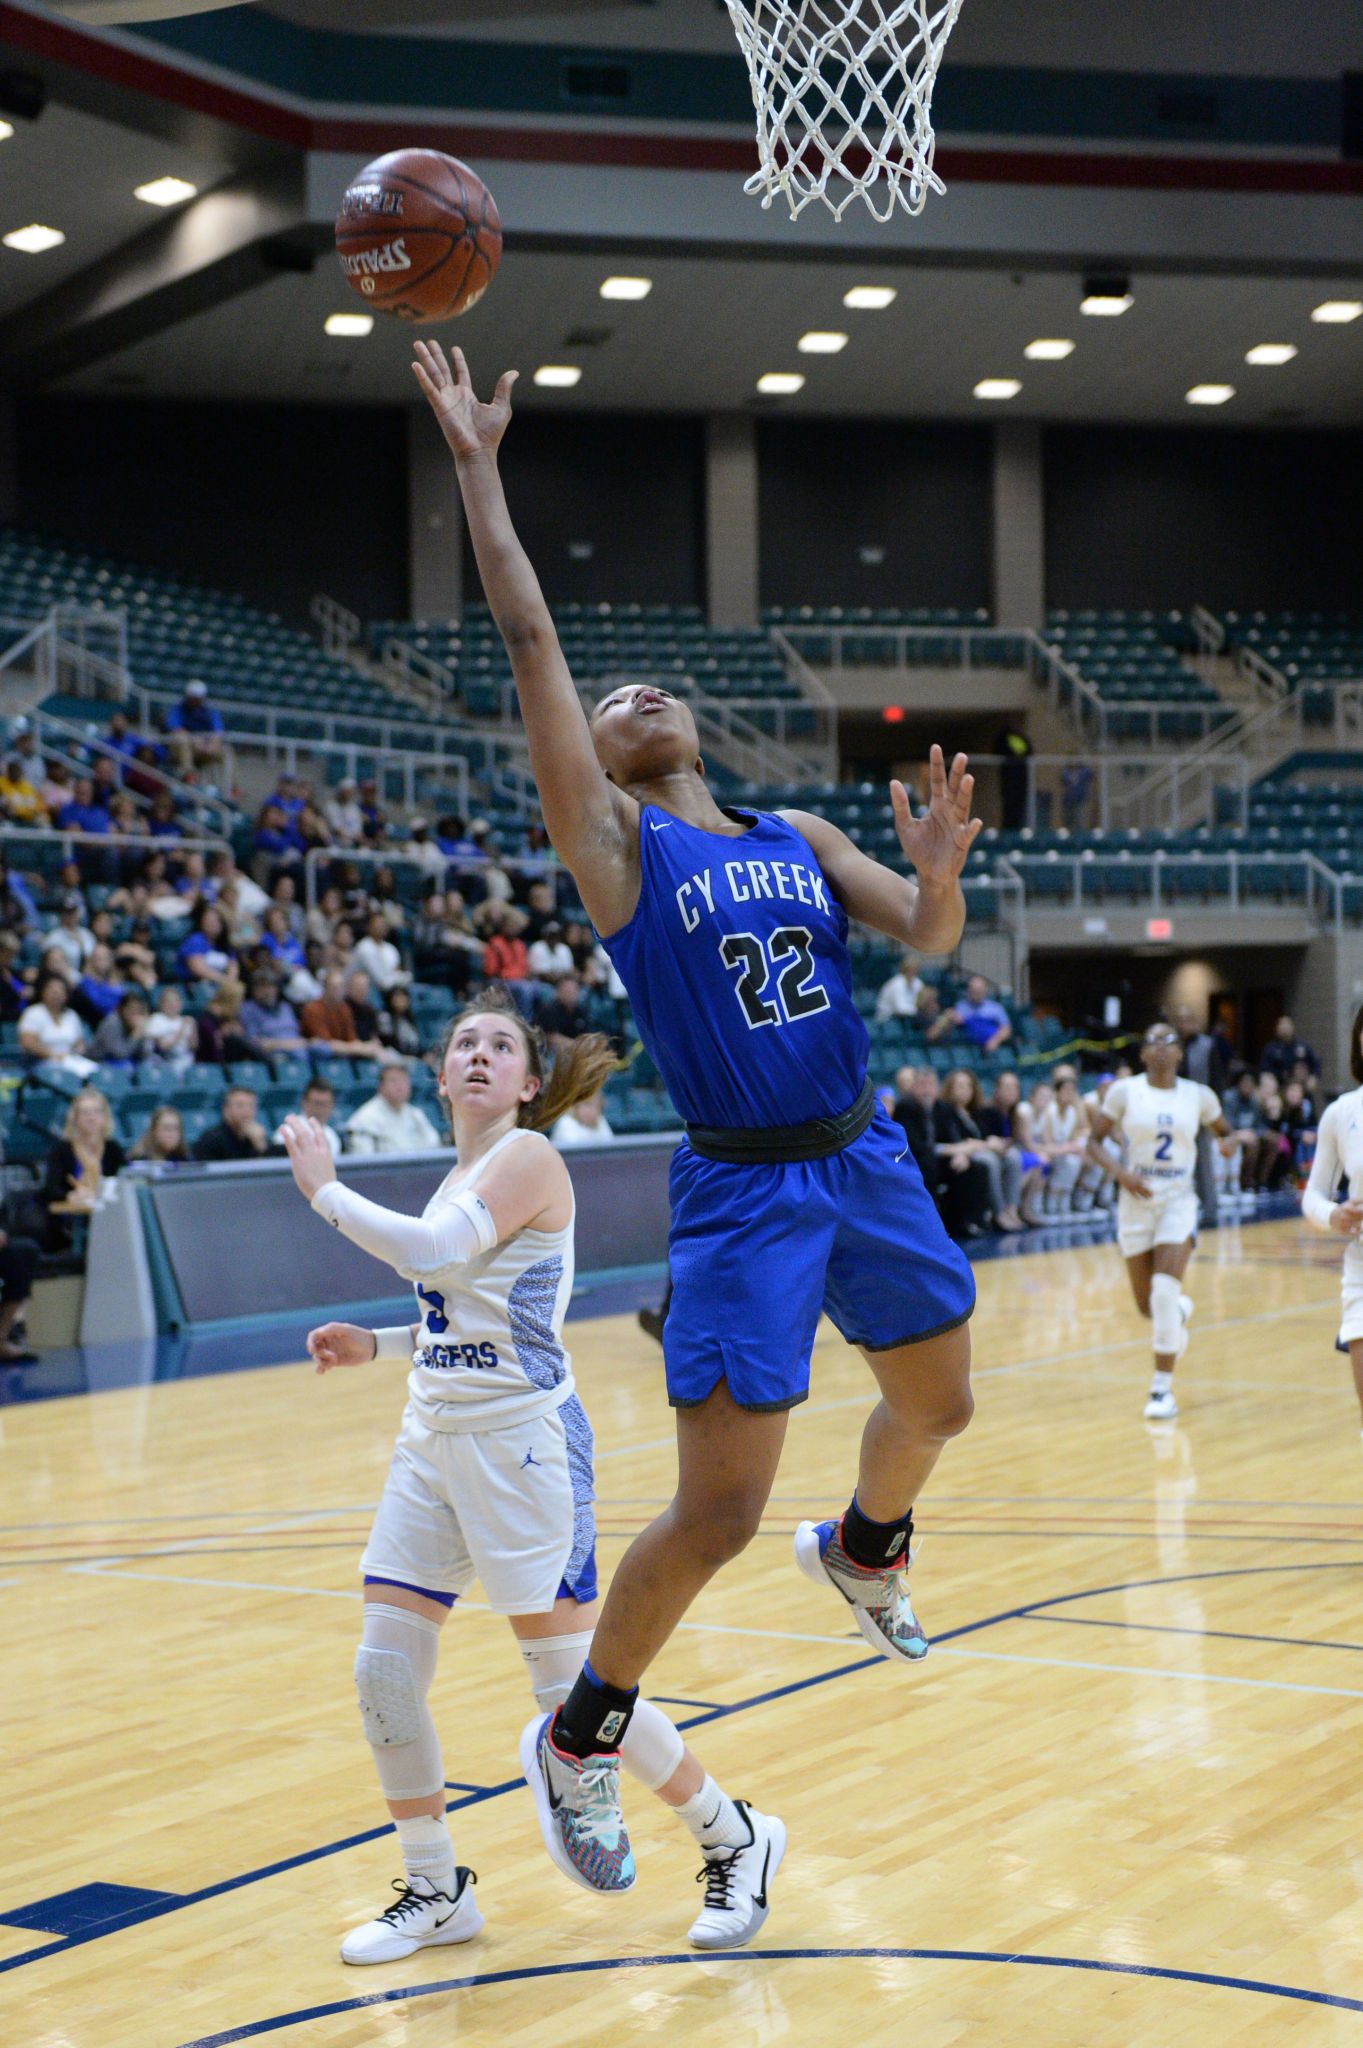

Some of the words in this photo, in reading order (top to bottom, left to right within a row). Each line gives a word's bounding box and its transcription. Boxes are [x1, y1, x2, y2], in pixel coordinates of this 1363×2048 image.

[341, 237, 411, 276] SPALD
[675, 868, 716, 934] CY
[724, 860, 831, 917] CREEK
[718, 926, 831, 1030] 22
[1154, 1131, 1174, 1161] 2
